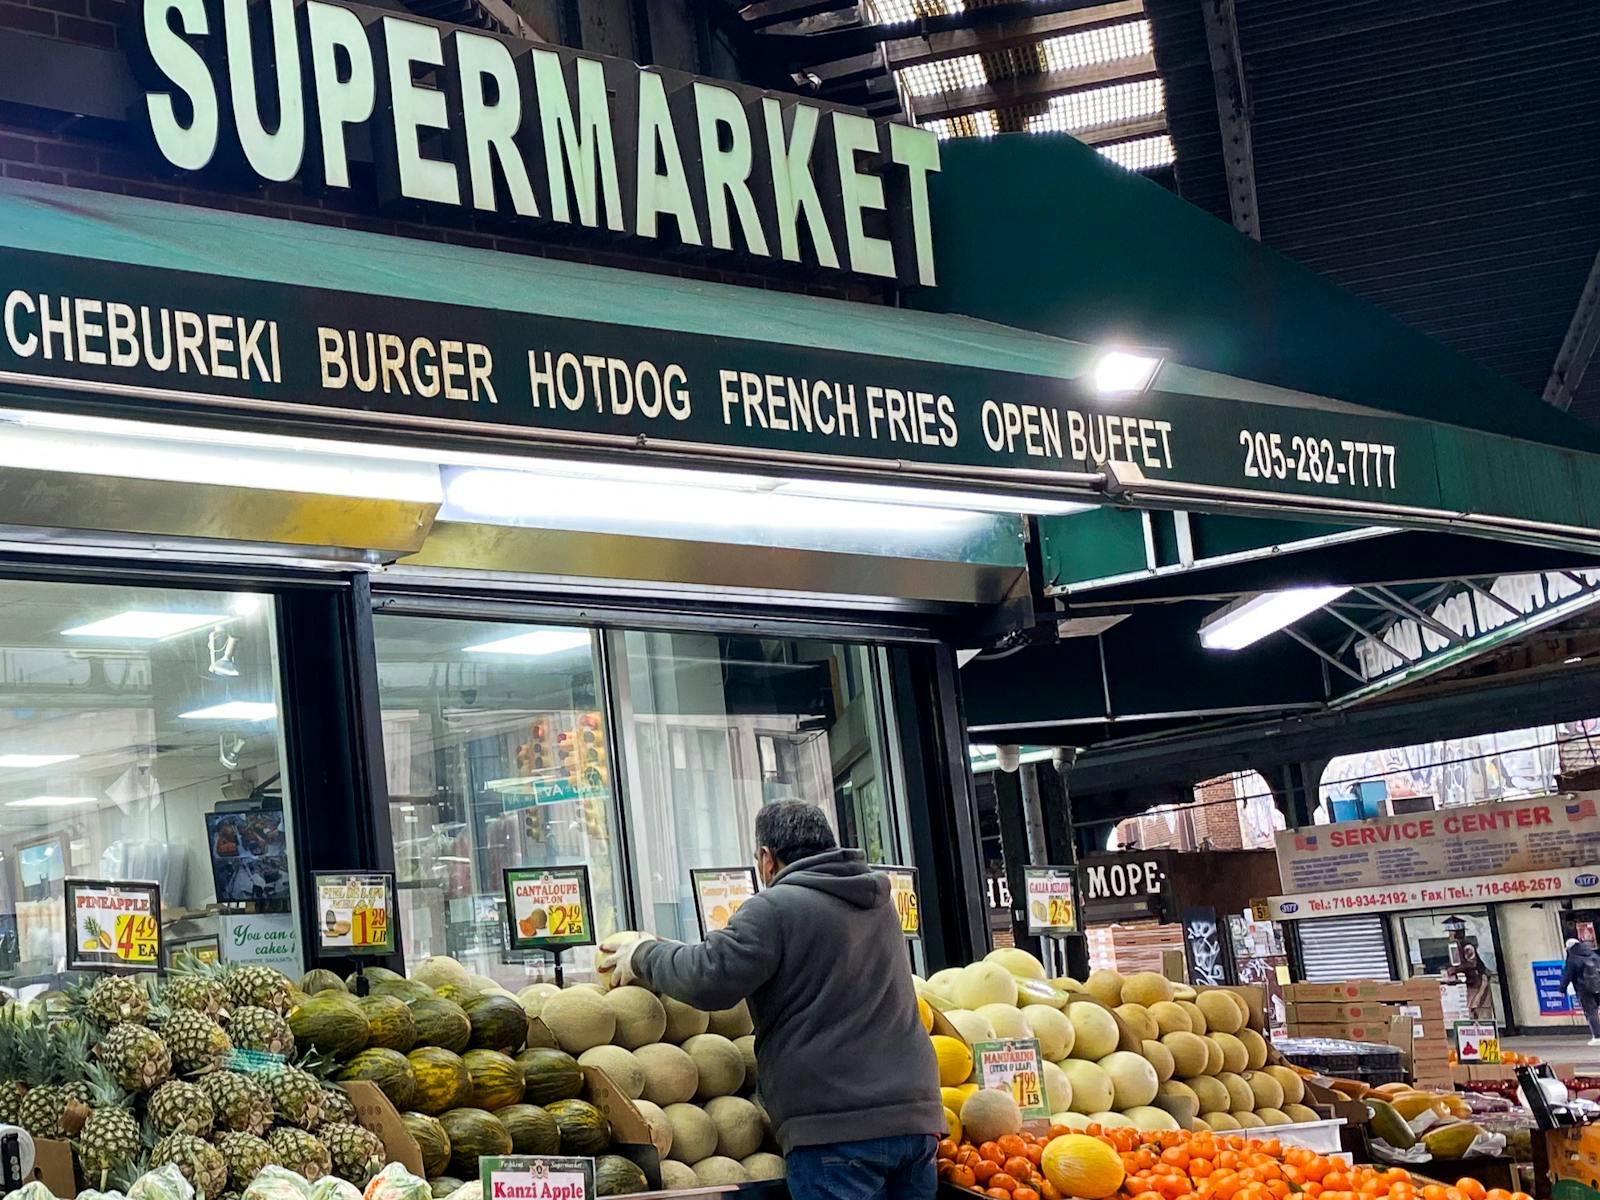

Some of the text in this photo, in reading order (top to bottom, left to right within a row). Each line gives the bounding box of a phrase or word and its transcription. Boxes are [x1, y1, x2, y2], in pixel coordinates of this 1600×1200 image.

[144, 0, 941, 287] SUPERMARKET
[3, 289, 1396, 489] CHEBUREKI BURGER HOTDOG FRENCH FRIES OPEN BUFFET 205-282-7777
[1330, 806, 1553, 848] SERVICE CENTER
[516, 883, 578, 897] CANTALOUPE
[76, 895, 150, 911] PINEAPPLE
[1333, 891, 1408, 909] 718-934-2192
[233, 923, 262, 947] You
[264, 930, 289, 940] can
[138, 943, 158, 957] EA
[255, 941, 289, 955] cakes
[1027, 1094, 1040, 1105] LB
[494, 1182, 584, 1200] Kanzi Apple
